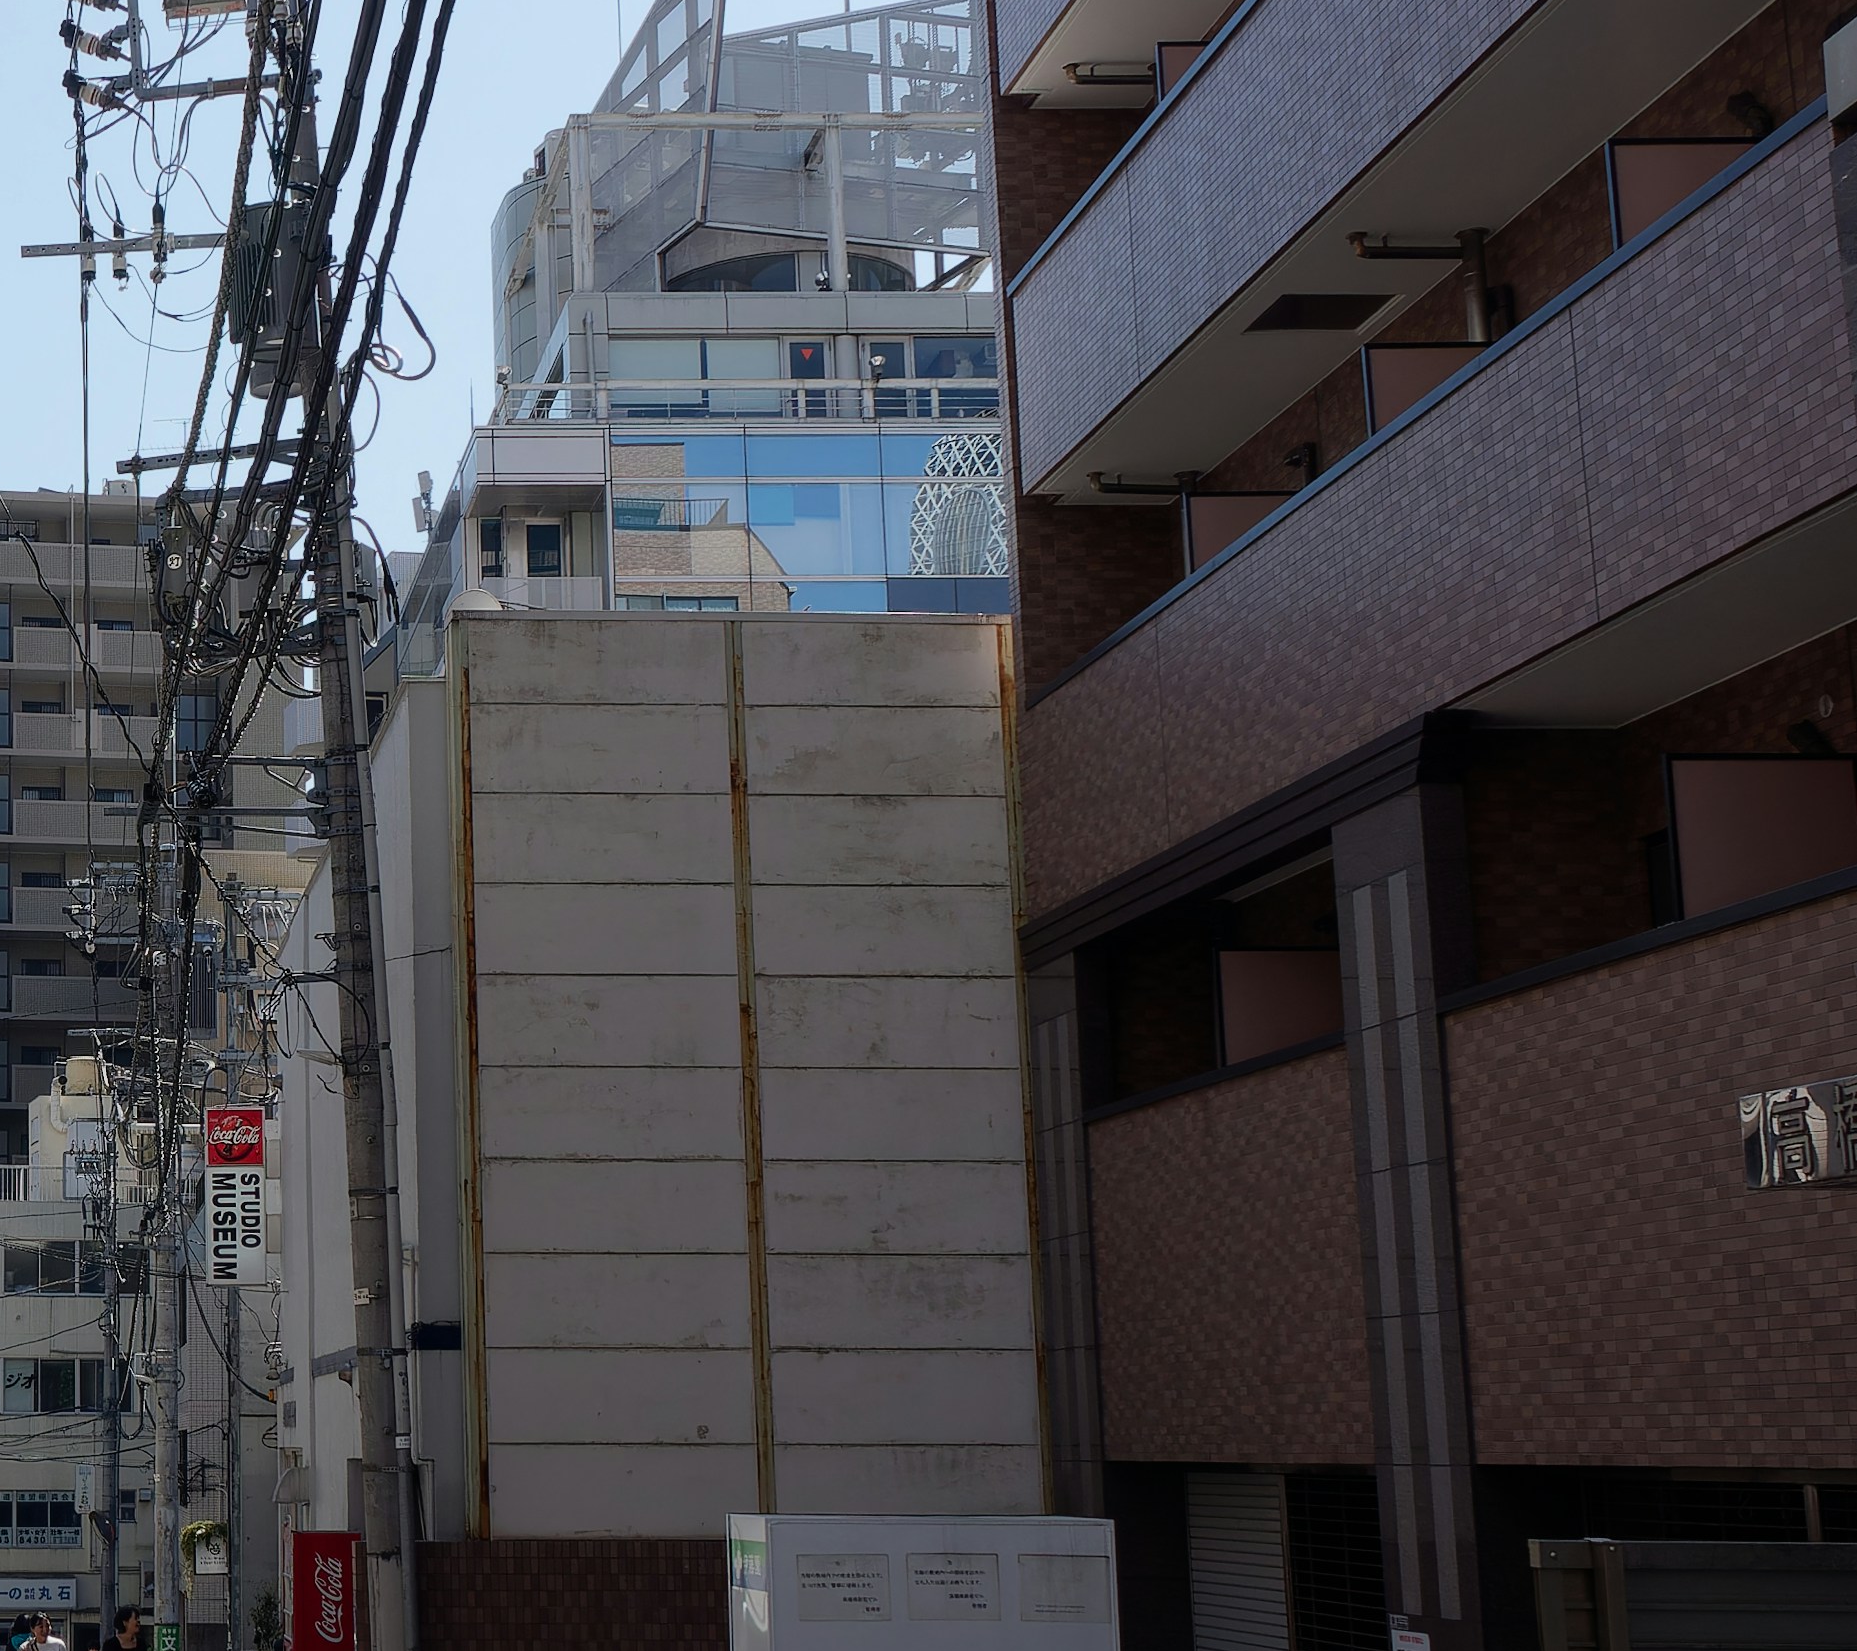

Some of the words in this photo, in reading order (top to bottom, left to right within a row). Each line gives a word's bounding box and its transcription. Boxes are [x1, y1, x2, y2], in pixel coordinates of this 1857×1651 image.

[212, 1173, 237, 1280] MUSEUM
[240, 1173, 261, 1248] STUDIO
[315, 1551, 343, 1643] Coca-Cola
[162, 1635, 177, 1651] 文
